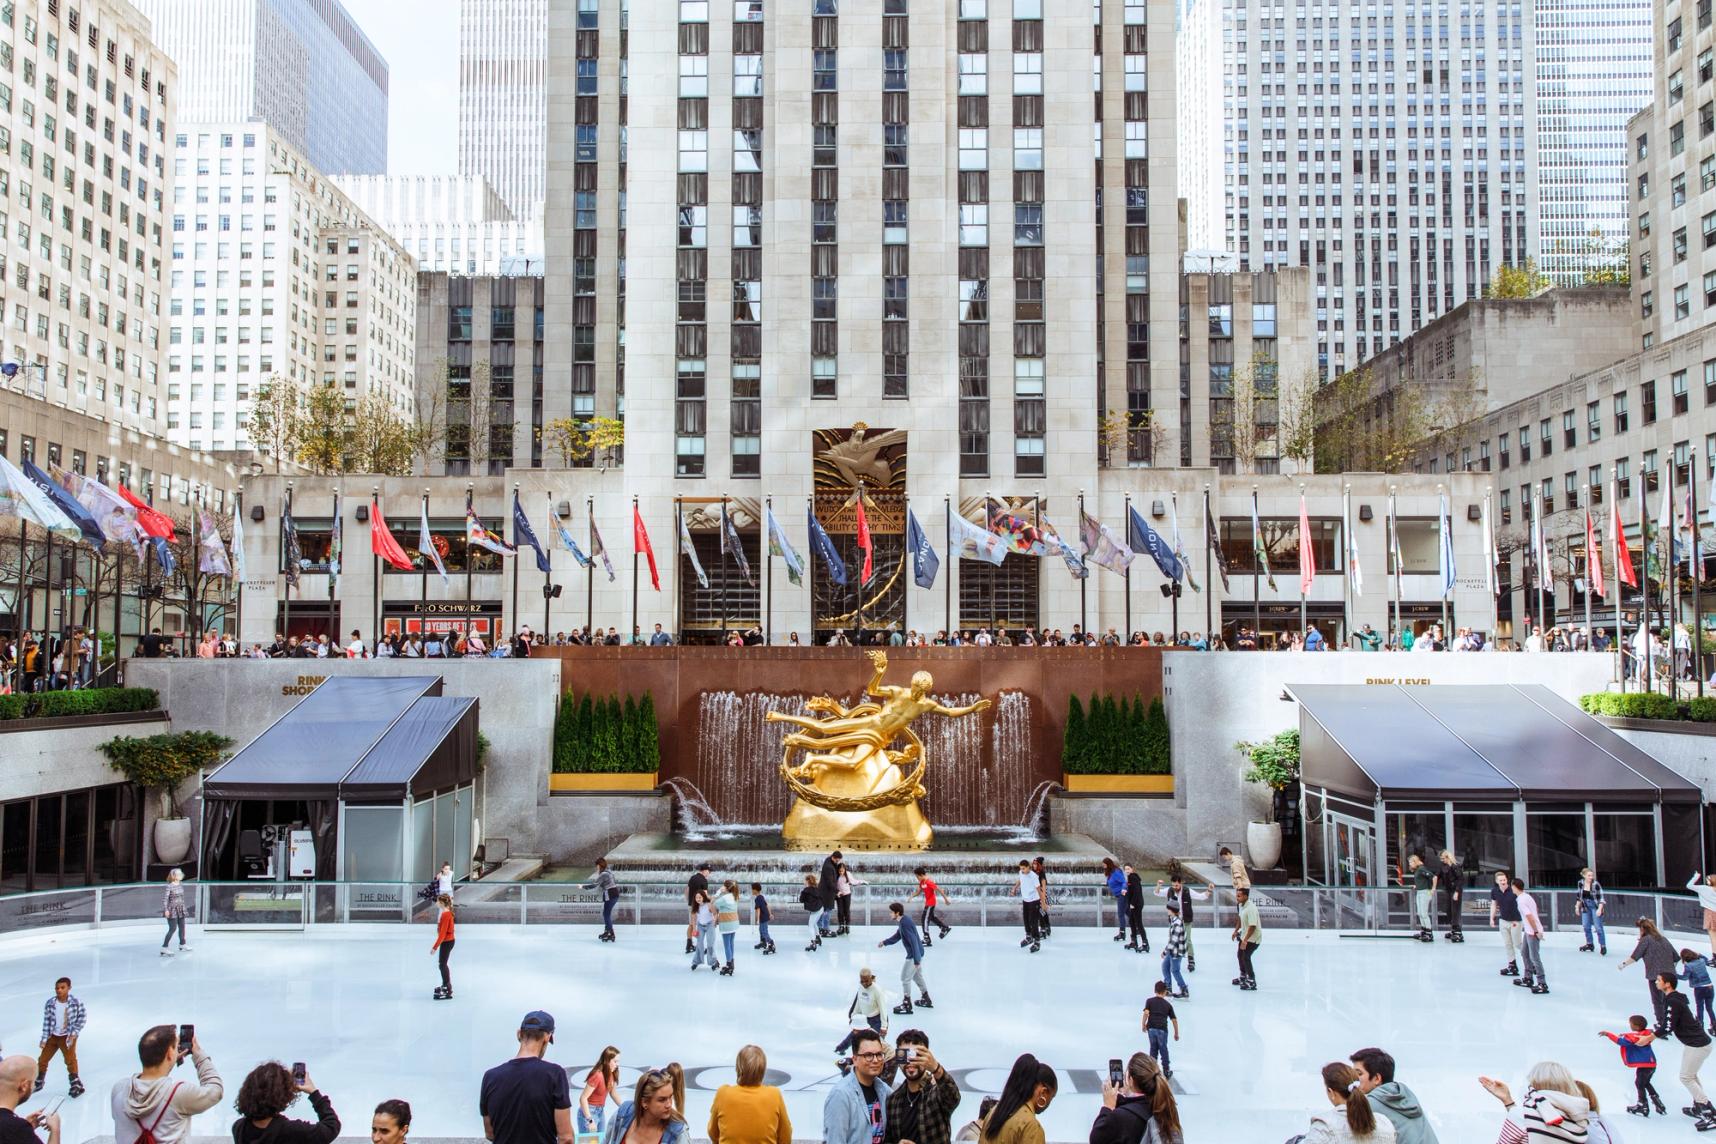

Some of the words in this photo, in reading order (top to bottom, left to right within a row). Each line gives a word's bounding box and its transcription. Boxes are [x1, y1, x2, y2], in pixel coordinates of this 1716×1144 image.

[282, 686, 317, 696] SHOP
[361, 893, 375, 902] THE
[377, 893, 397, 902] RINK
[561, 894, 577, 903] THE
[579, 894, 600, 903] RINK
